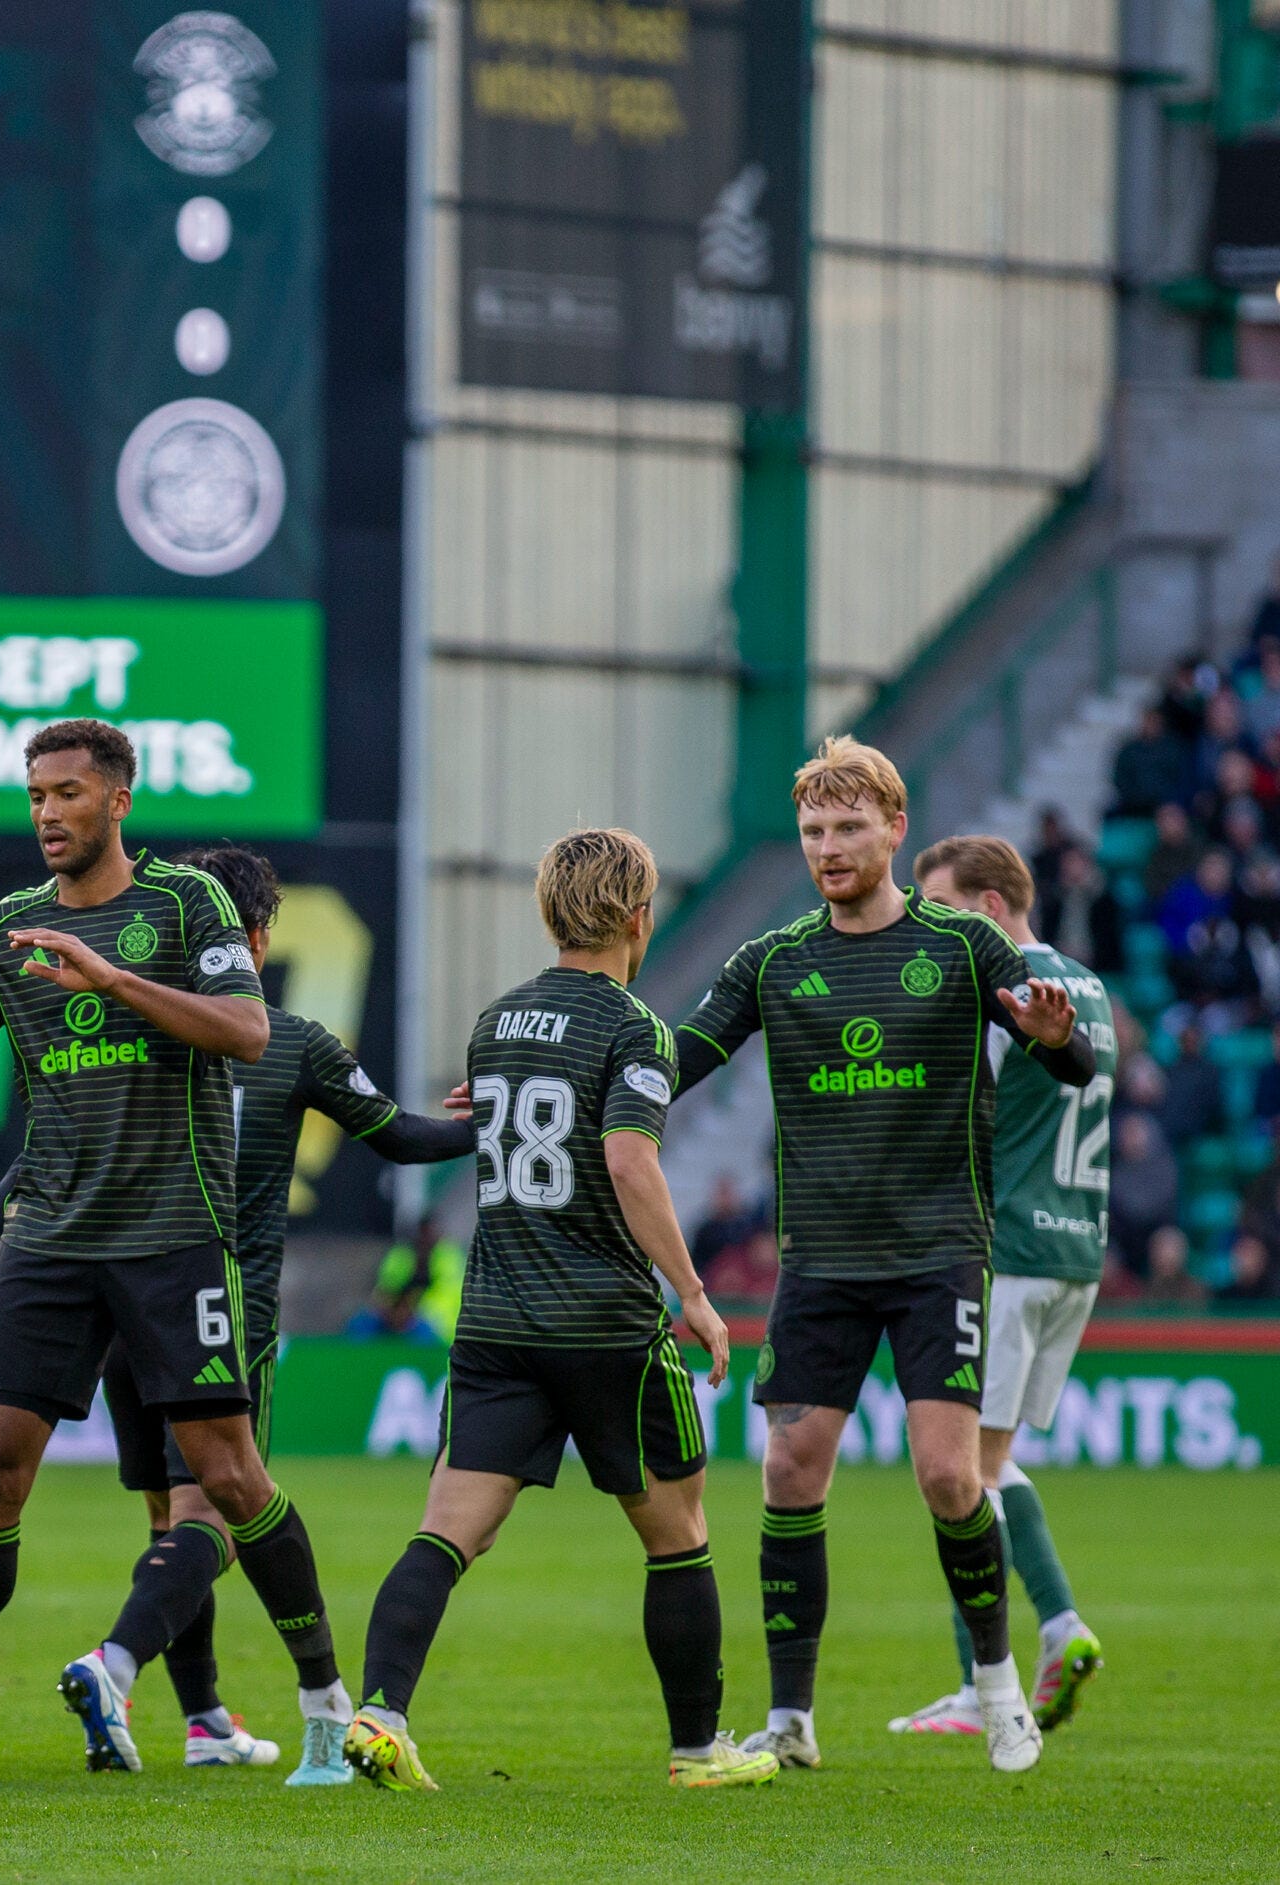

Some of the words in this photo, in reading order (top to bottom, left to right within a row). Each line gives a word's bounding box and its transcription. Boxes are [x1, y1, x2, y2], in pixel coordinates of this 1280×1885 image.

[494, 1011, 569, 1043] DAIZEN
[40, 1037, 149, 1075] dafabet
[808, 1061, 927, 1096] dafabet
[473, 1073, 576, 1210] 38
[1053, 1073, 1113, 1192] 12
[196, 1288, 231, 1347] 6
[955, 1300, 981, 1357] 5
[276, 1612, 320, 1632] CELTIC
